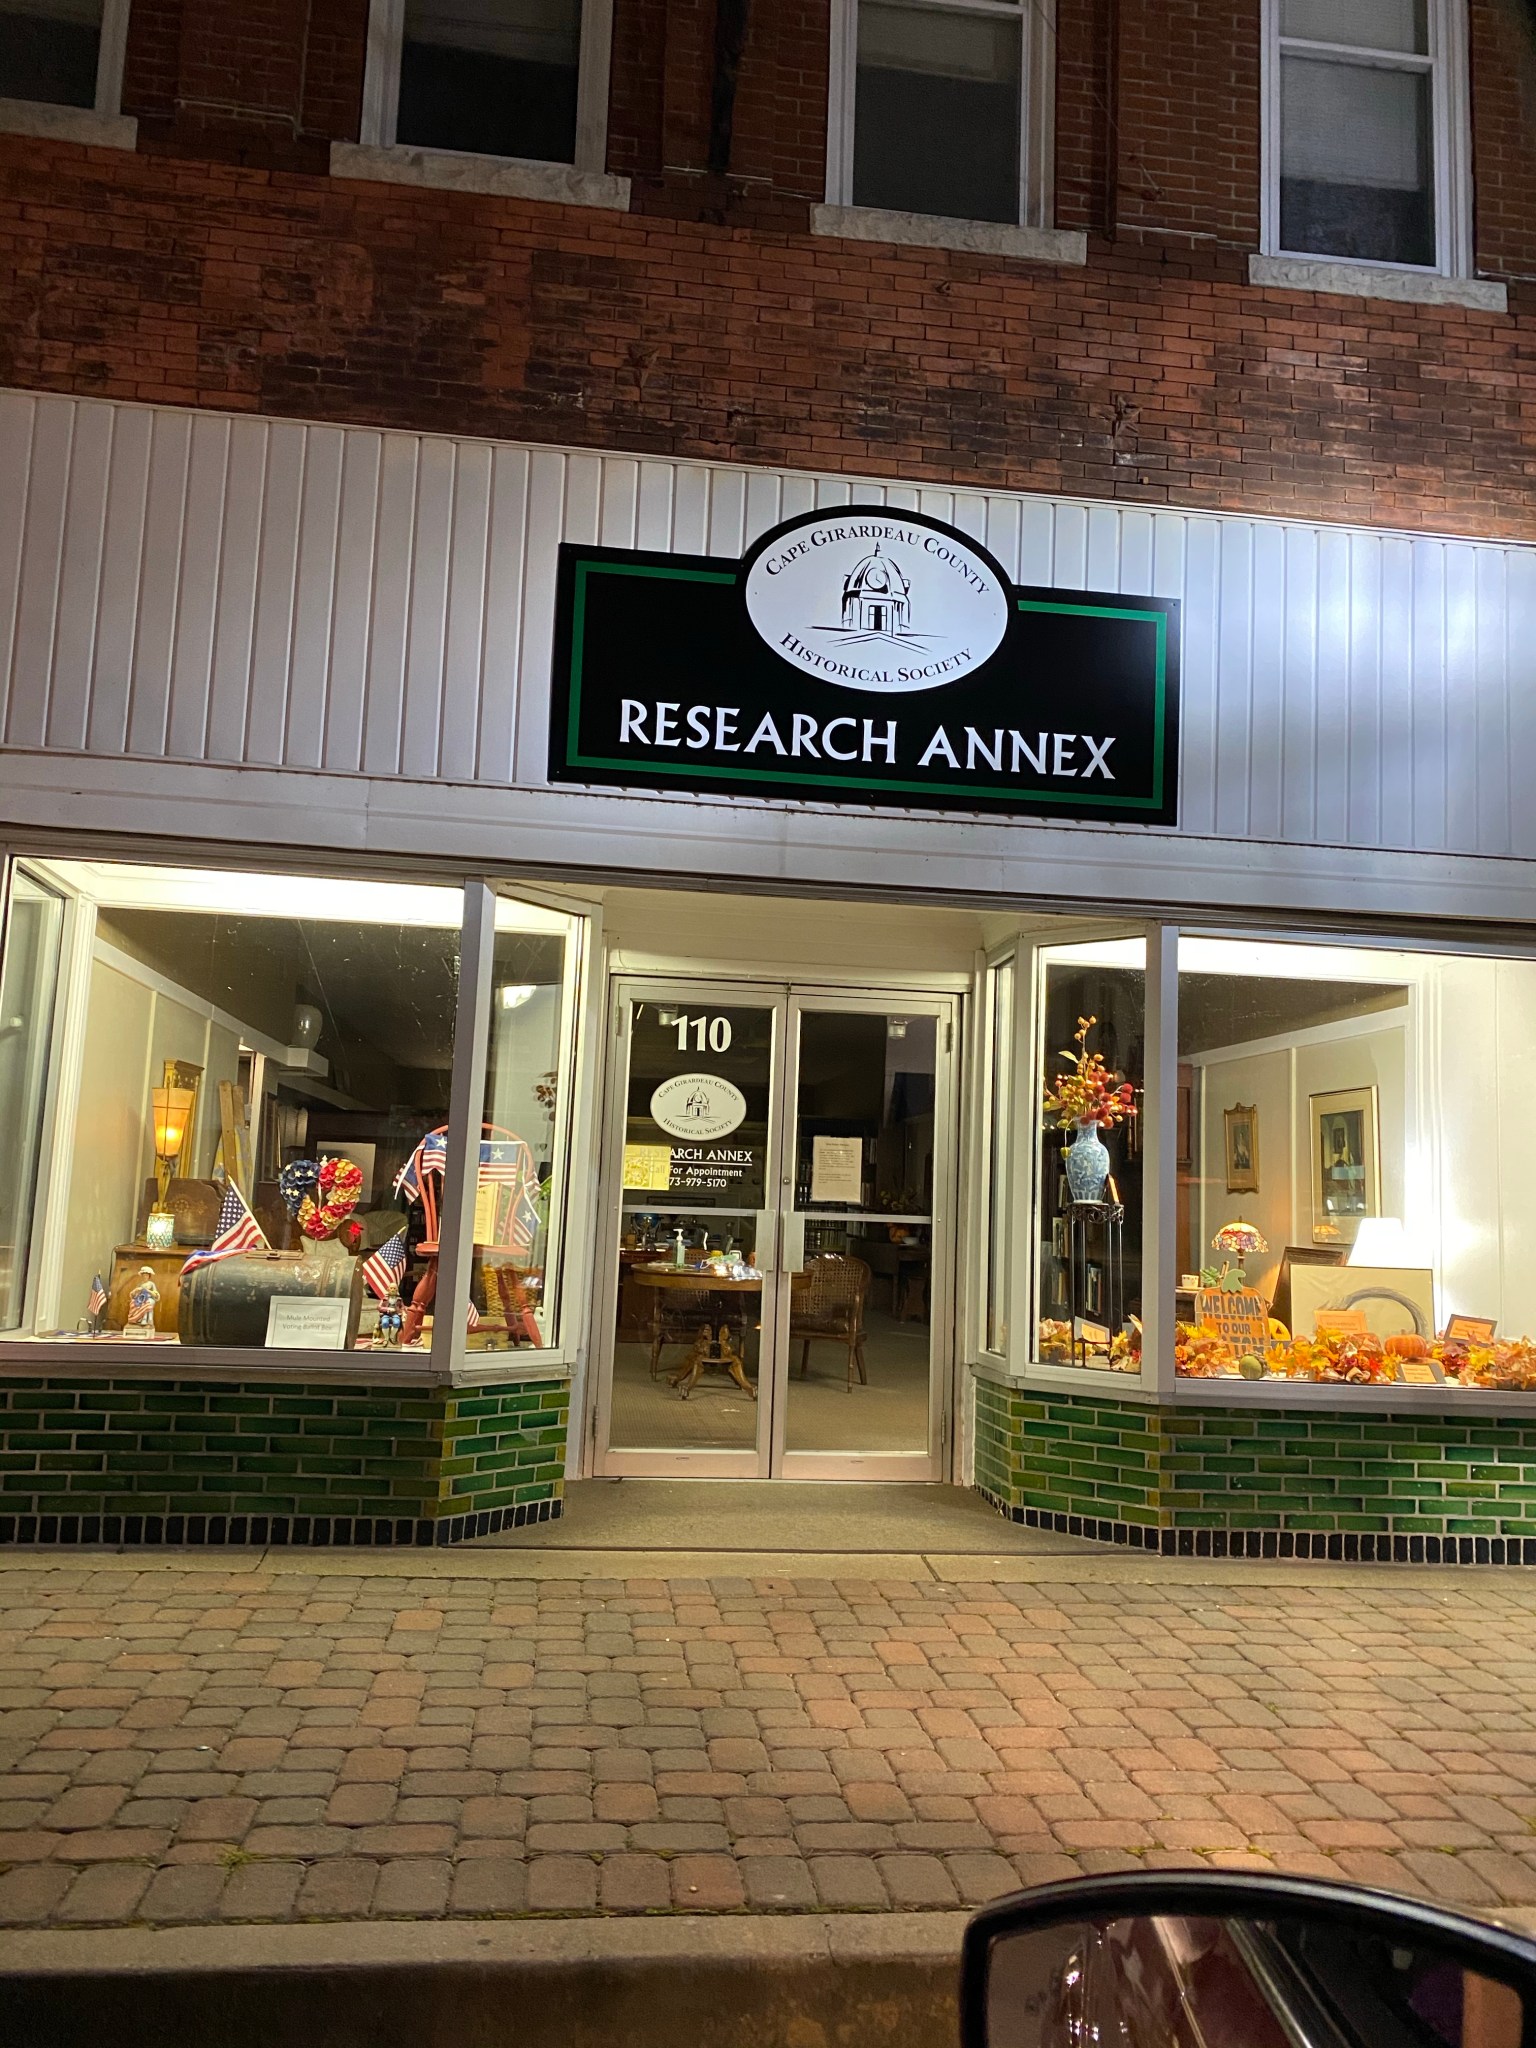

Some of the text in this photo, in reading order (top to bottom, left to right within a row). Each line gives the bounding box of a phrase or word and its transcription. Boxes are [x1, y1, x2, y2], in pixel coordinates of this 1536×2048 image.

[766, 525, 990, 594] CAPE GIRARDEAU COUNTY
[779, 632, 973, 683] HISTORICAL SOCIETY
[619, 699, 1117, 780] RESEARCH ANNEX
[670, 1014, 732, 1053] 110
[658, 1078, 738, 1101] CAPE GIRARDEAU COUNTY
[663, 1118, 733, 1135] HISTORICAL SOCIETY
[706, 1149, 752, 1162] ANNEX
[686, 1166, 743, 1178] Appointment
[1200, 1295, 1264, 1321] WELCOME
[282, 1323, 302, 1331] Voting
[1216, 1322, 1251, 1335] TO OUR
